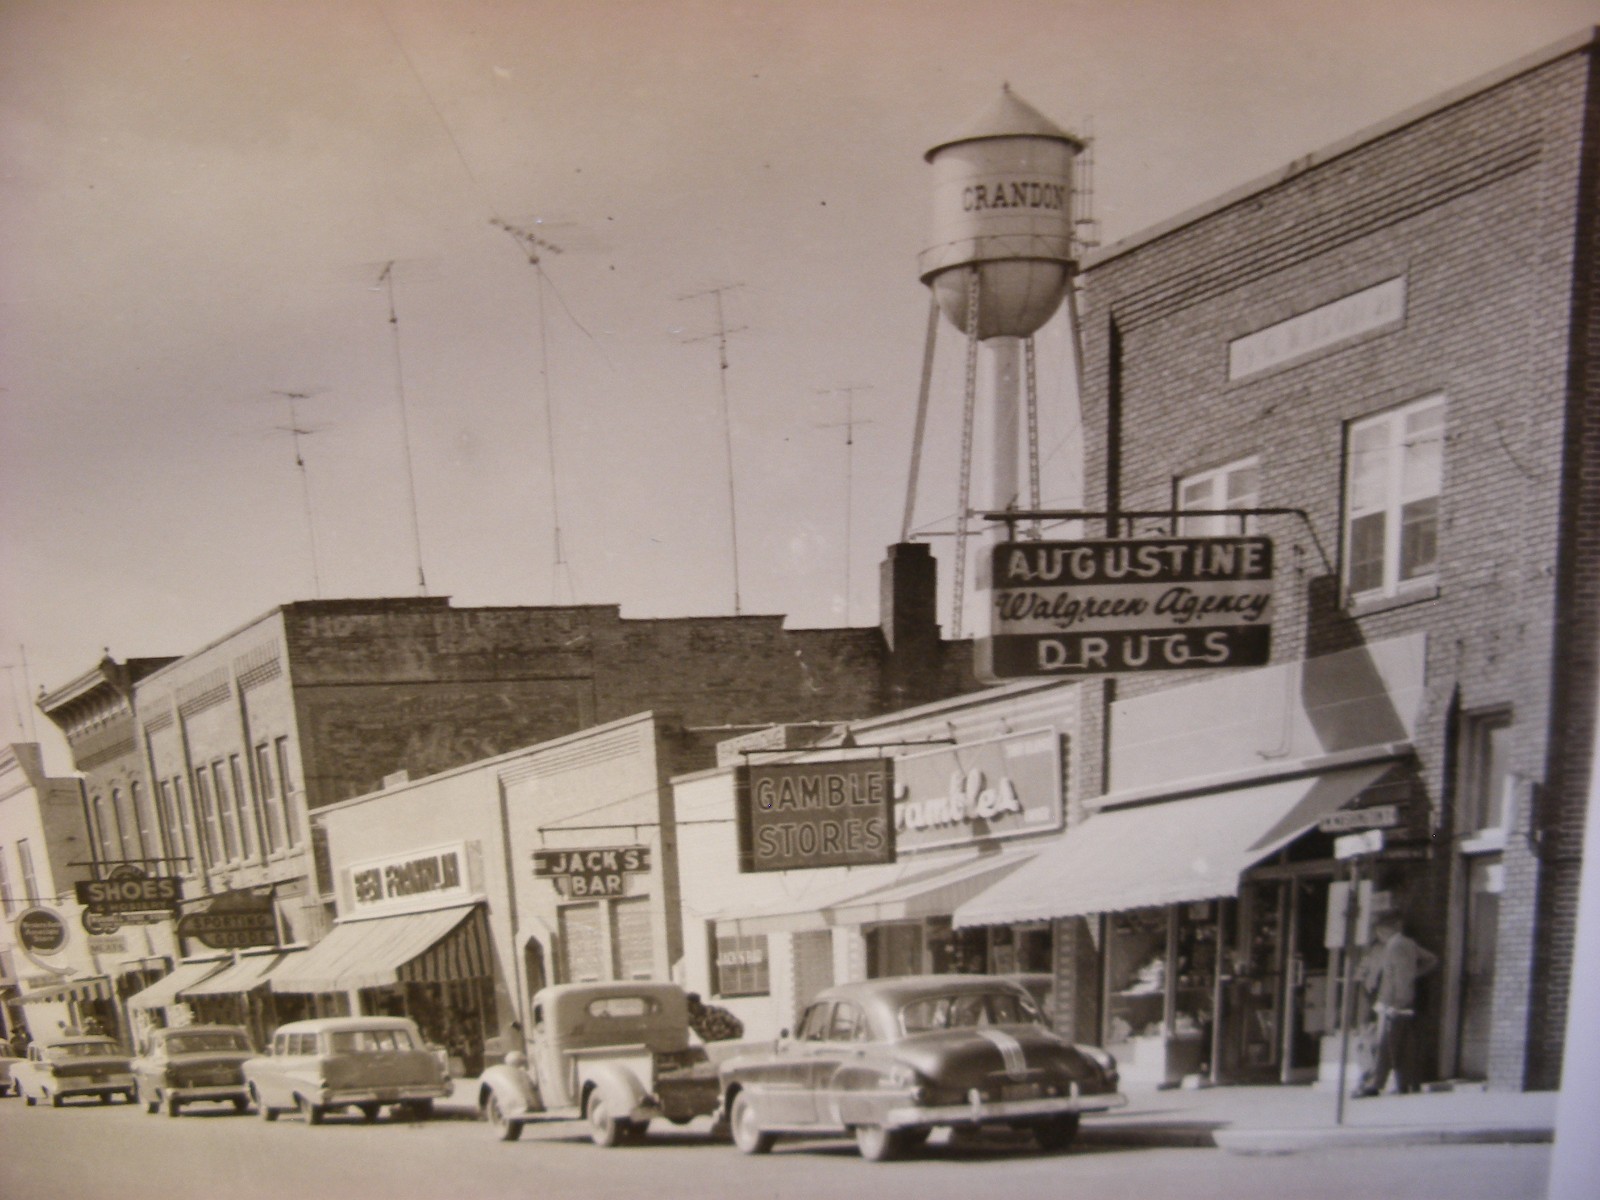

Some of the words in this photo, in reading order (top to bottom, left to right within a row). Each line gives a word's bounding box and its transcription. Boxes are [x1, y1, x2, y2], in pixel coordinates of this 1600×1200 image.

[962, 182, 1065, 211] CRANDON
[1007, 541, 1267, 580] AUGUSTINE
[995, 590, 1149, 629] Walgreen
[1153, 586, 1272, 624] Agency
[1037, 632, 1231, 670] DRUGS
[755, 771, 884, 812] GAMBLE
[895, 768, 1020, 831] ambles
[757, 818, 885, 858] STORES
[552, 849, 640, 874] JACK'S
[88, 880, 175, 903] SHOES
[570, 875, 623, 897] BAR
[193, 913, 267, 929] SPORTING
